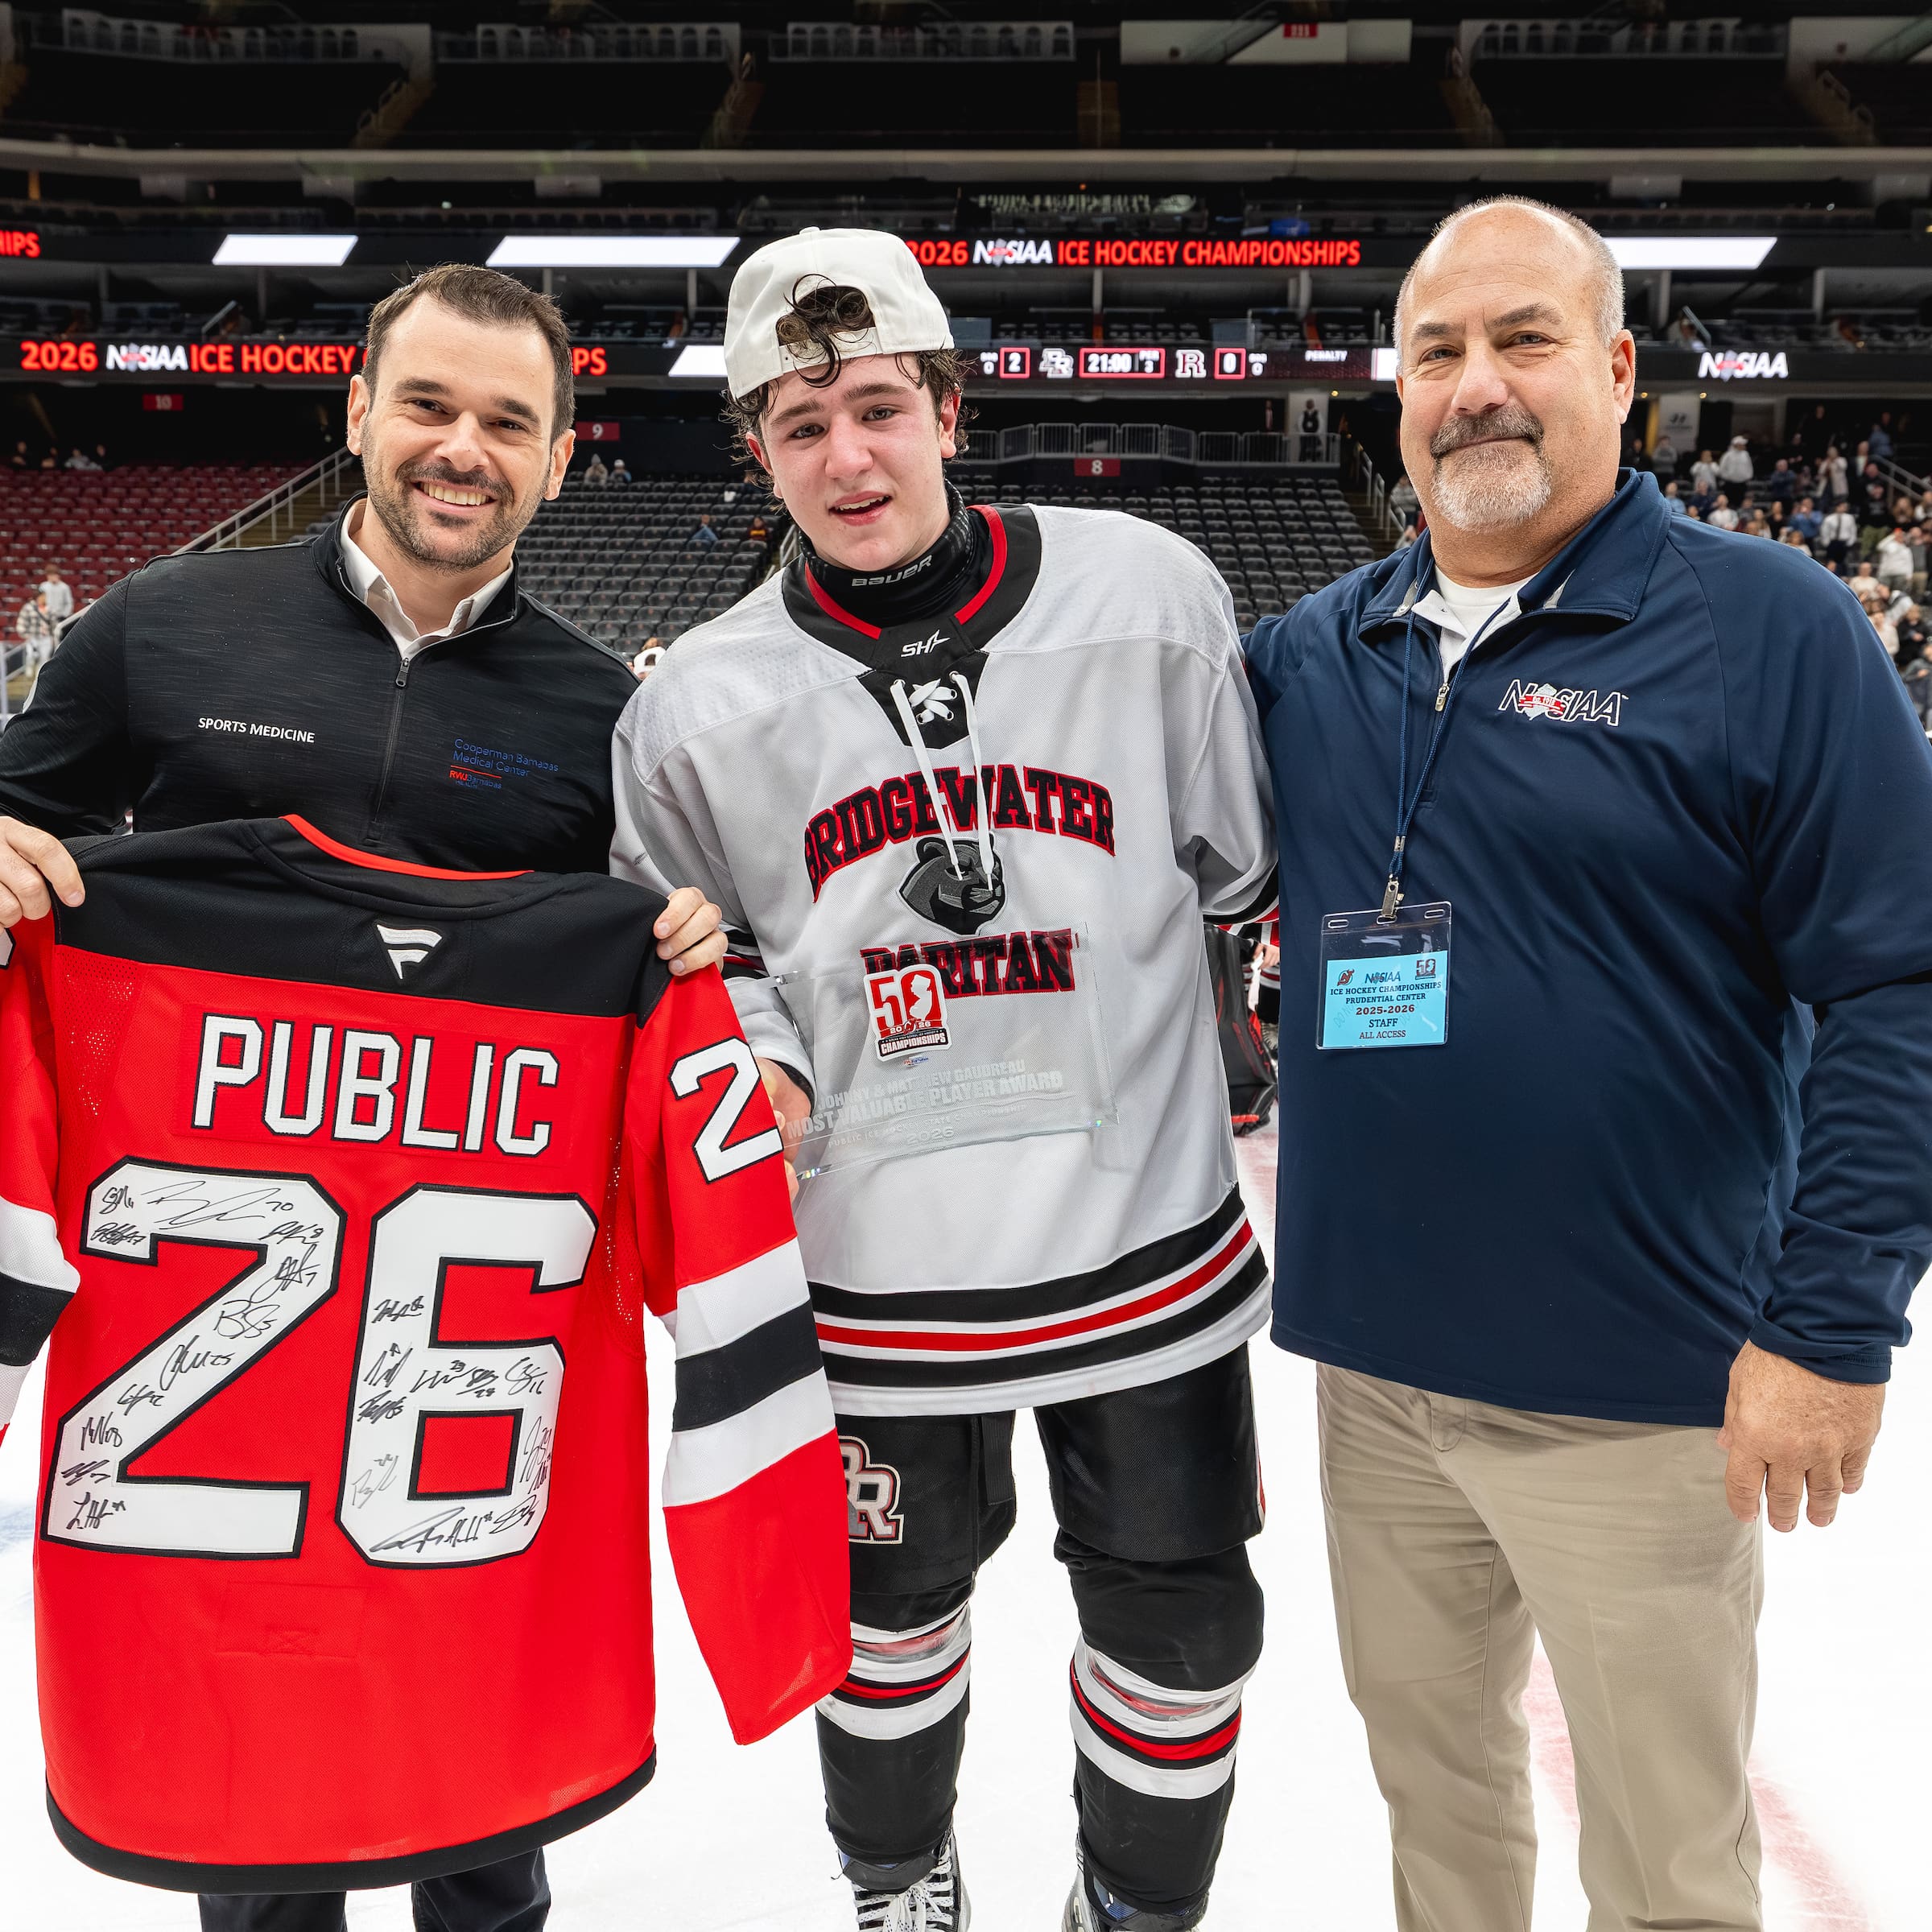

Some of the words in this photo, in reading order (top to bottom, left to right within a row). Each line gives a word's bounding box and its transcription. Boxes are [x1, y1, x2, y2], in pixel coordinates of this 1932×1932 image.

[1057, 240, 1090, 266] ICE
[1094, 240, 1179, 266] HOCKEY
[1183, 240, 1360, 266] CHAMPIONSHIPS
[20, 341, 98, 371] 2026
[190, 344, 234, 373] ICE
[241, 344, 357, 374] HOCKEY
[1008, 352, 1022, 373] 2
[1088, 353, 1133, 373] 21:00
[1174, 349, 1207, 378] R
[1223, 353, 1236, 374] 0
[1305, 349, 1348, 361] PENALTY
[592, 423, 604, 440] 9
[1091, 459, 1104, 476] 8
[198, 717, 247, 733] SPORTS
[250, 724, 316, 743] MEDICINE
[454, 738, 514, 762] Cooperman
[453, 751, 494, 770] Medical
[496, 762, 530, 777] Center
[804, 764, 1116, 903] BRIDGEWATER
[1345, 986, 1377, 995] HOCKEY
[1379, 981, 1442, 993] CHAMPIONSHIPS
[1345, 994, 1394, 1004] PRUDENTIAL
[1396, 993, 1426, 1001] CENTER
[869, 970, 943, 1037] 50
[1356, 1004, 1415, 1015] 2025-2026
[1359, 1030, 1375, 1039] ALL
[1376, 1030, 1406, 1038] ACCESS
[1368, 1018, 1398, 1028] STAFF
[881, 1033, 946, 1055] CHAMPIONSHIPS
[192, 1013, 559, 1158] PUBLIC
[786, 1113, 836, 1140] MOST
[838, 1090, 927, 1129] VALUABLE
[929, 1079, 997, 1108] PLAYER
[999, 1070, 1064, 1096] AWARD
[818, 1087, 869, 1111] JOHNNY
[668, 1036, 785, 1186] 2
[906, 1125, 956, 1146] 2026
[40, 1155, 599, 1569] 26
